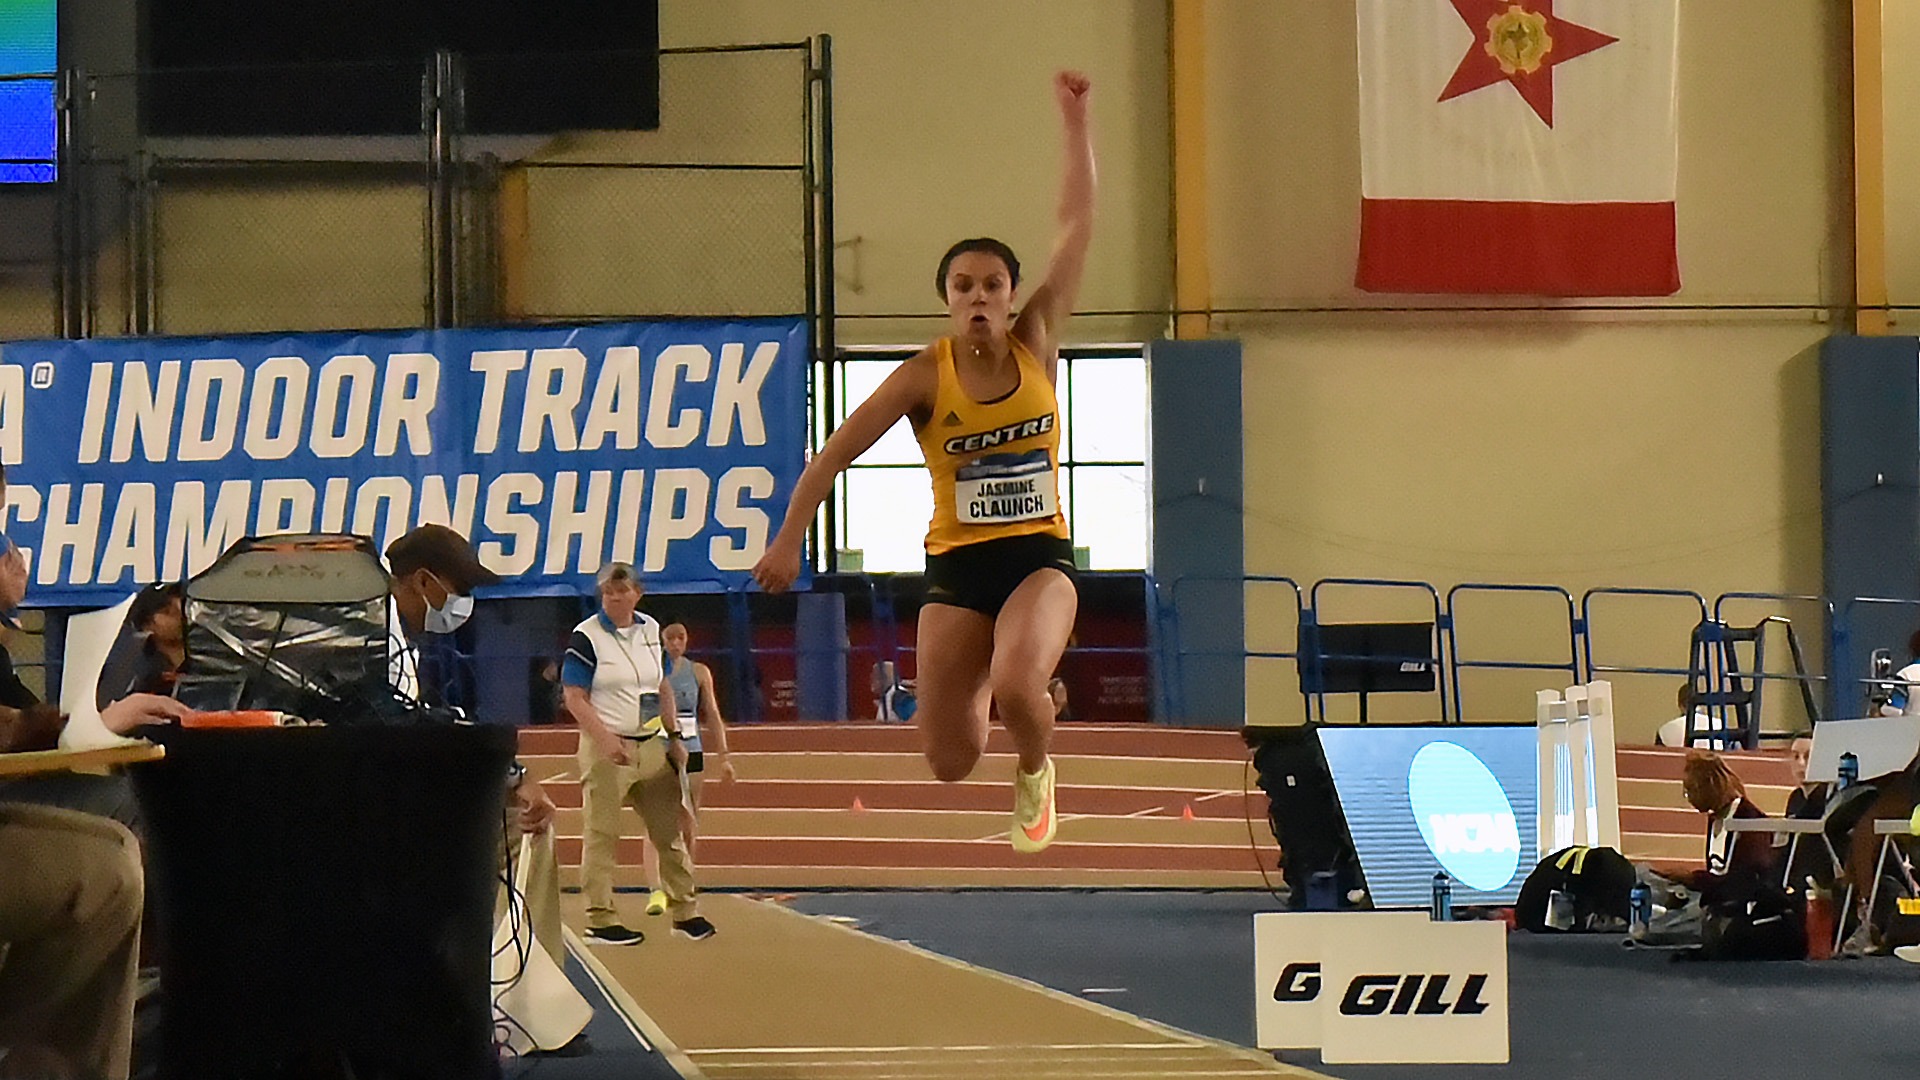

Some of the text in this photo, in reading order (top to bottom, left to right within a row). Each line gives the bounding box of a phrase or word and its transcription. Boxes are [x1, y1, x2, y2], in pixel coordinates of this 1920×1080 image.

[78, 353, 440, 464] INDOOR
[470, 341, 780, 454] TRACK
[944, 412, 1054, 454] CENTRE
[969, 495, 1044, 518] CLAUNCH
[977, 480, 1036, 497] JASMINE
[1339, 973, 1489, 1015] GILL
